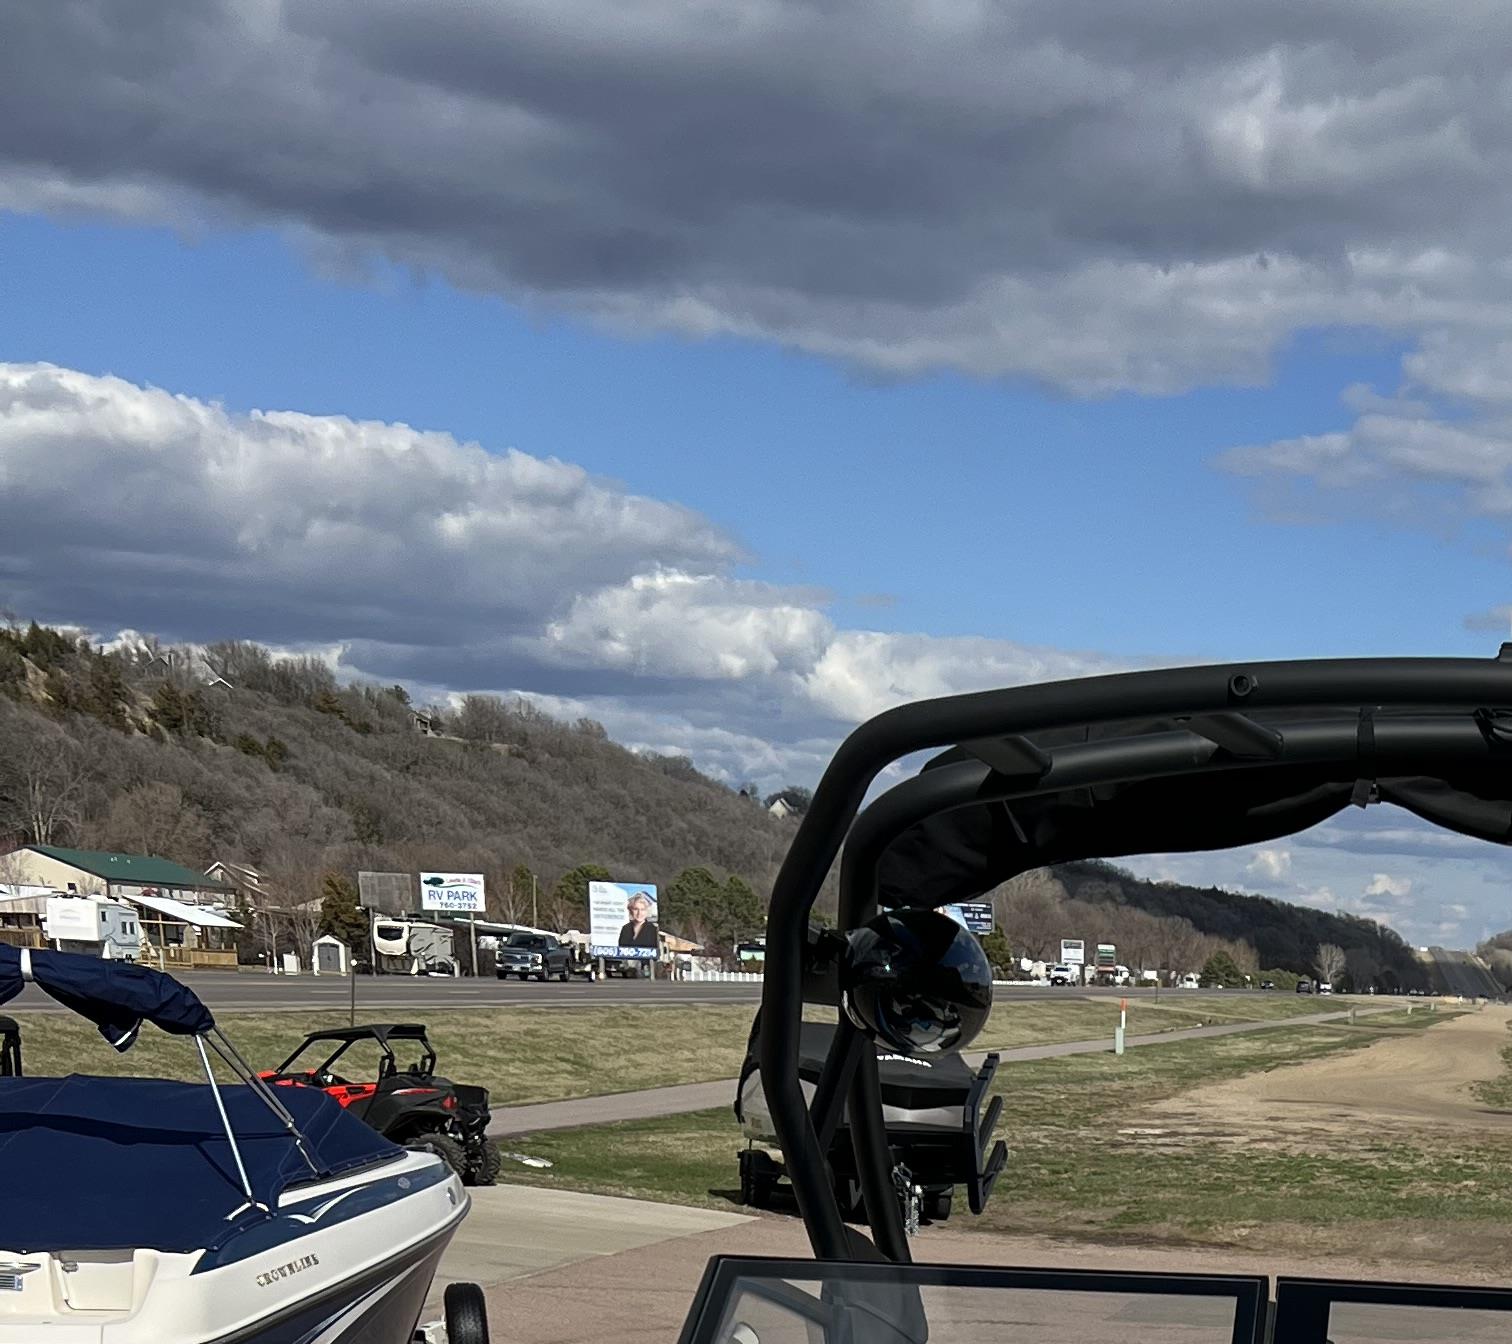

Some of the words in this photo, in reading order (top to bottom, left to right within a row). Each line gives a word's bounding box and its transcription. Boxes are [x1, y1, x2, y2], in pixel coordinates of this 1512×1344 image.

[428, 890, 443, 900] RV
[447, 890, 477, 901] PARK
[256, 1254, 320, 1287] CROWNLINE
